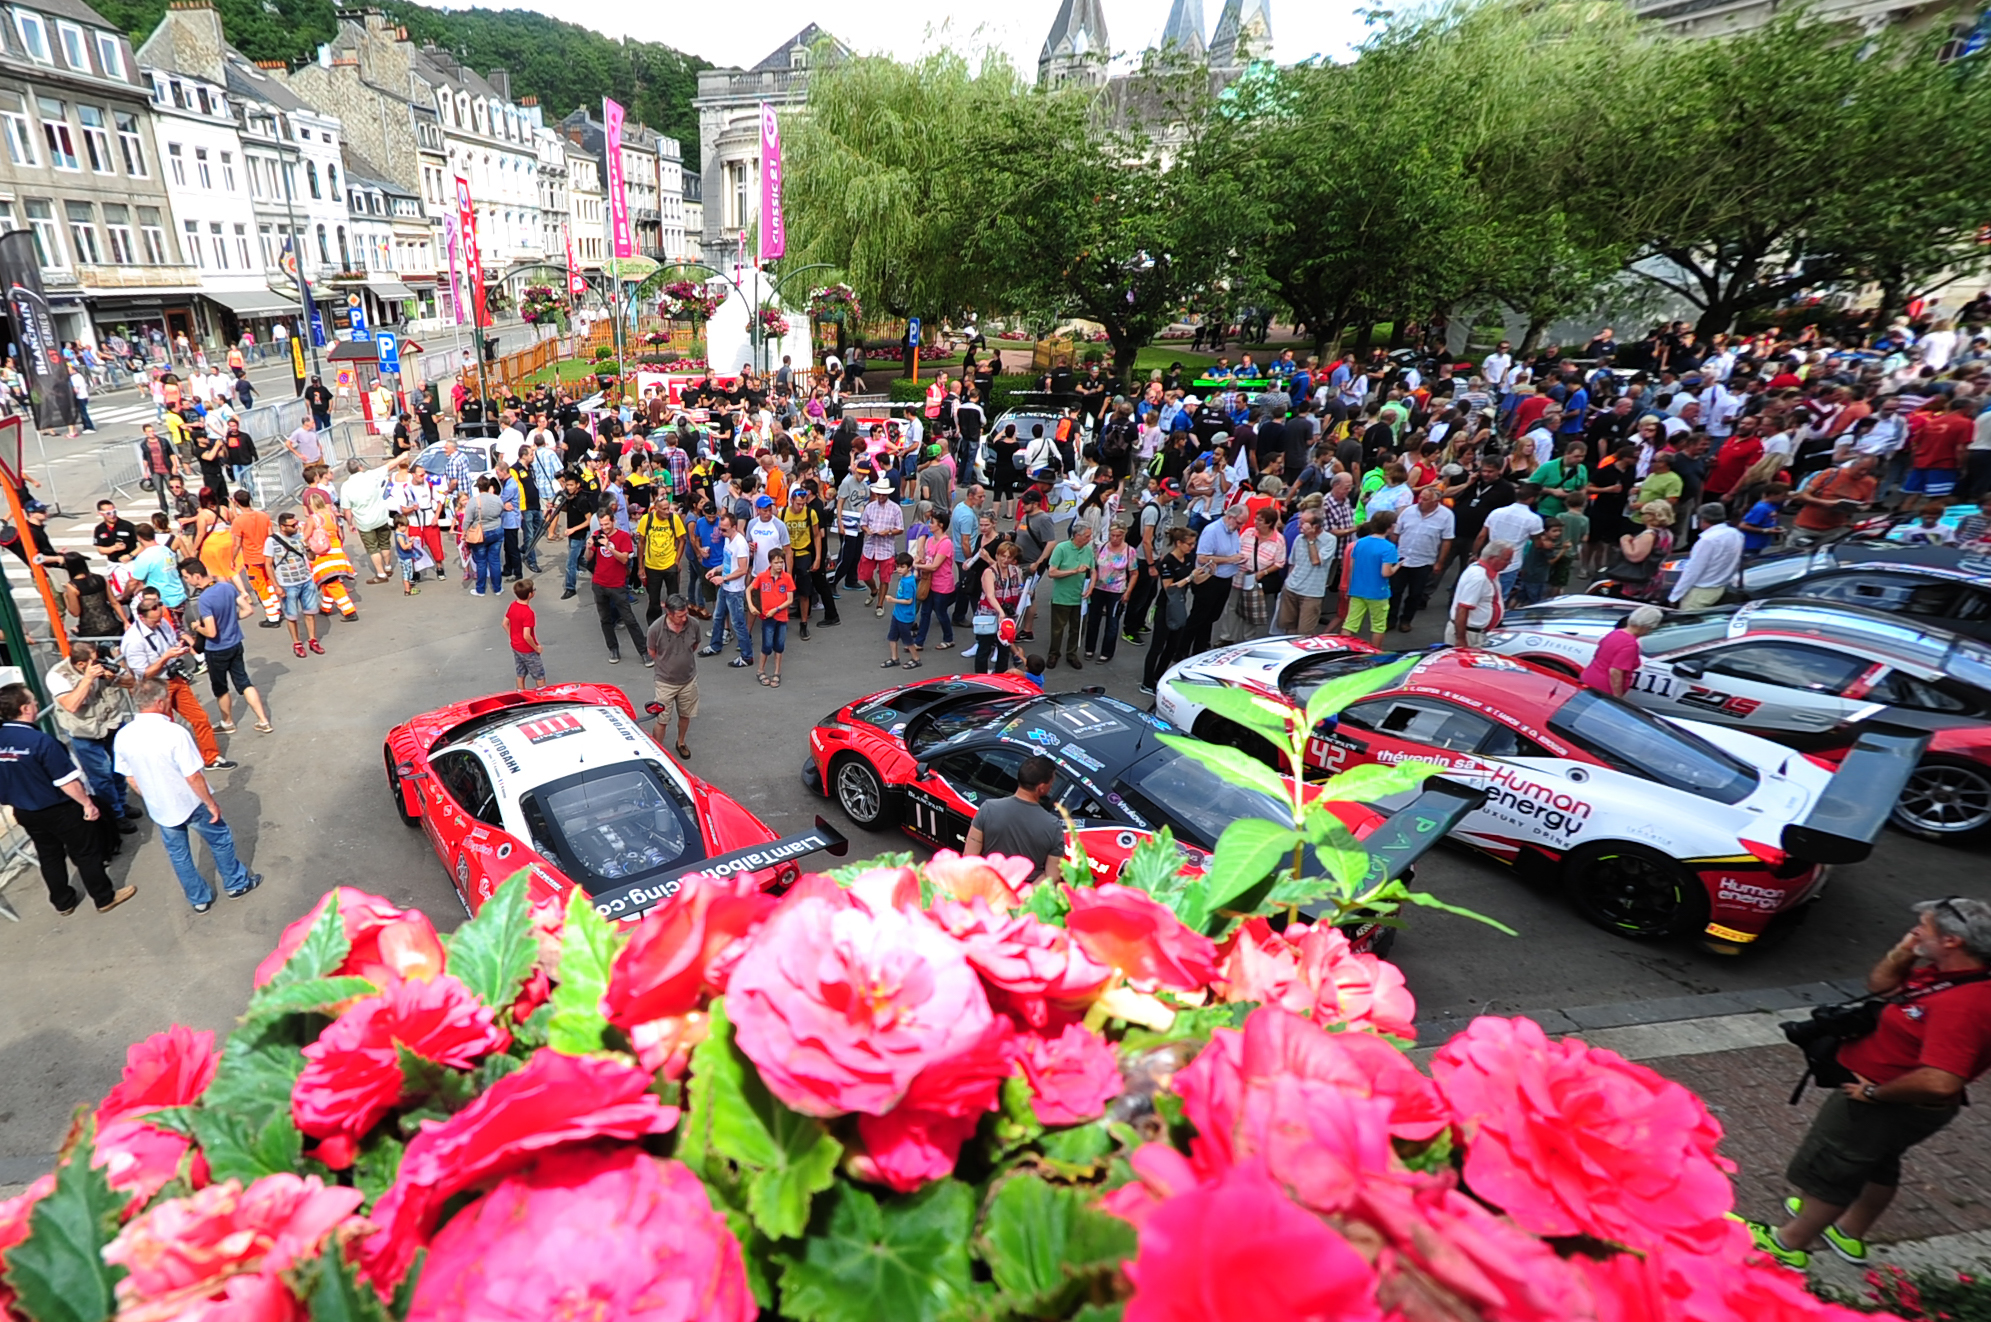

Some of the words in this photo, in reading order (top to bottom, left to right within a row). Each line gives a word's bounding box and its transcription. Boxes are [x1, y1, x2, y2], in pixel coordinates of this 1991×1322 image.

[769, 158, 778, 181] 21
[771, 183, 780, 244] CLASSIC
[463, 217, 480, 295] TOT
[351, 310, 361, 327] P
[18, 300, 49, 376] BLANCPAIN
[379, 336, 394, 359] P
[488, 735, 521, 774] AUTOBAHN
[1311, 739, 1346, 773] 42
[1453, 757, 1476, 769] sa
[907, 790, 945, 813] BLANCPAIN
[1490, 765, 1593, 819] Human
[915, 802, 937, 836] 11
[1481, 807, 1525, 828] UXURY
[1484, 785, 1583, 838] energy
[1720, 877, 1786, 898] Human
